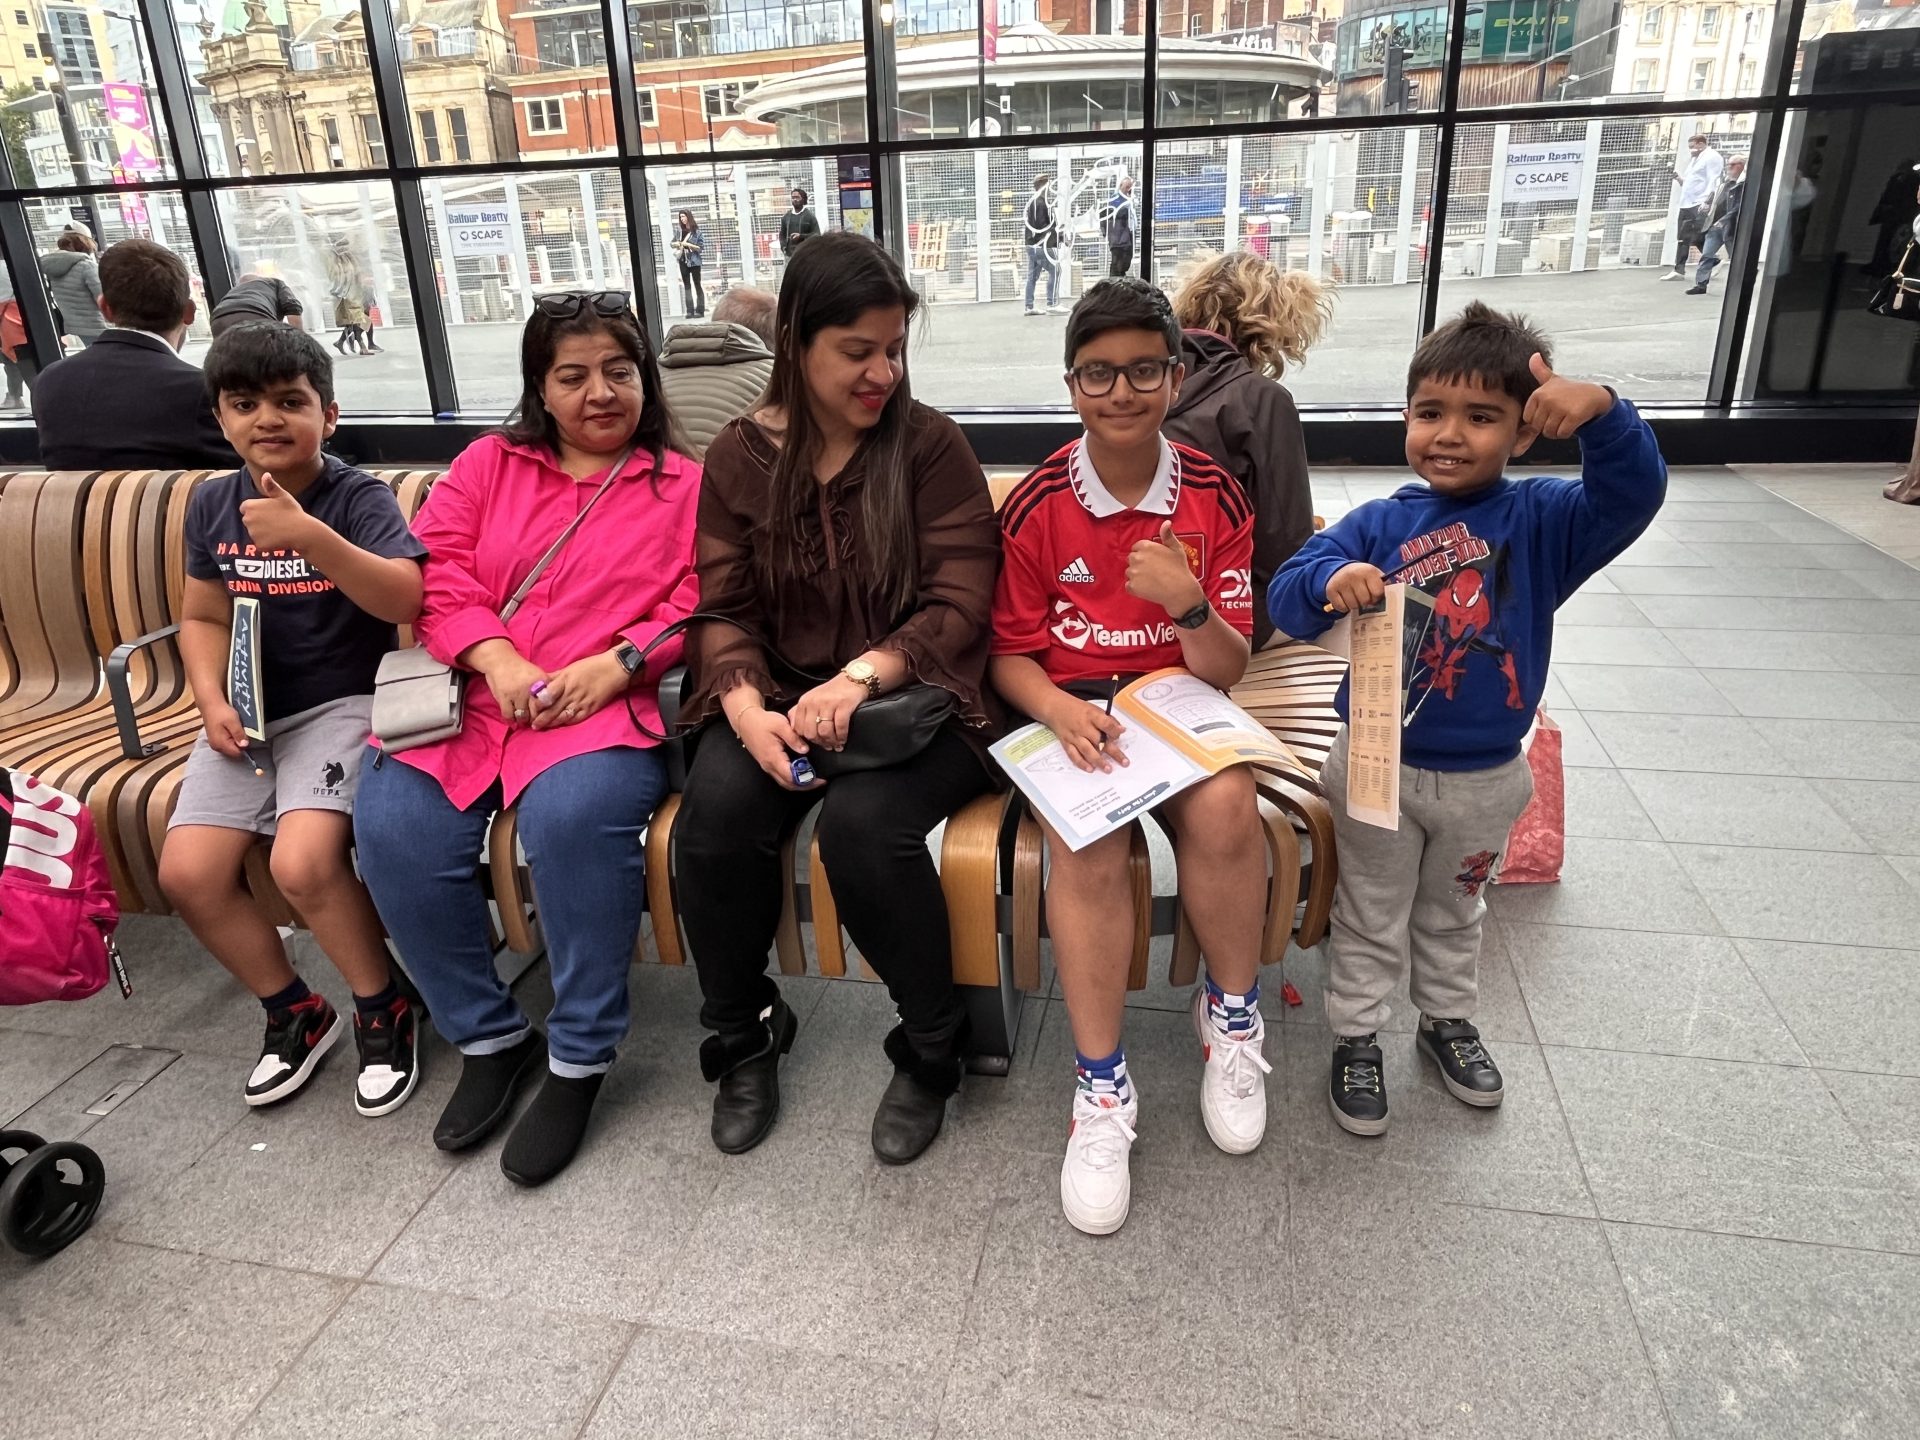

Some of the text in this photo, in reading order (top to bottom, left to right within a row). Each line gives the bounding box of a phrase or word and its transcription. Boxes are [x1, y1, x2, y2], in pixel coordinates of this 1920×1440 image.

[1529, 172, 1569, 183] SCAPE
[448, 211, 508, 224] Balfour Beatty
[471, 230, 503, 240] SCAPE
[263, 558, 310, 579] DIESEL
[1059, 572, 1095, 583] adidas
[268, 579, 335, 595] DIVISION
[1090, 622, 1176, 647] TeamVie
